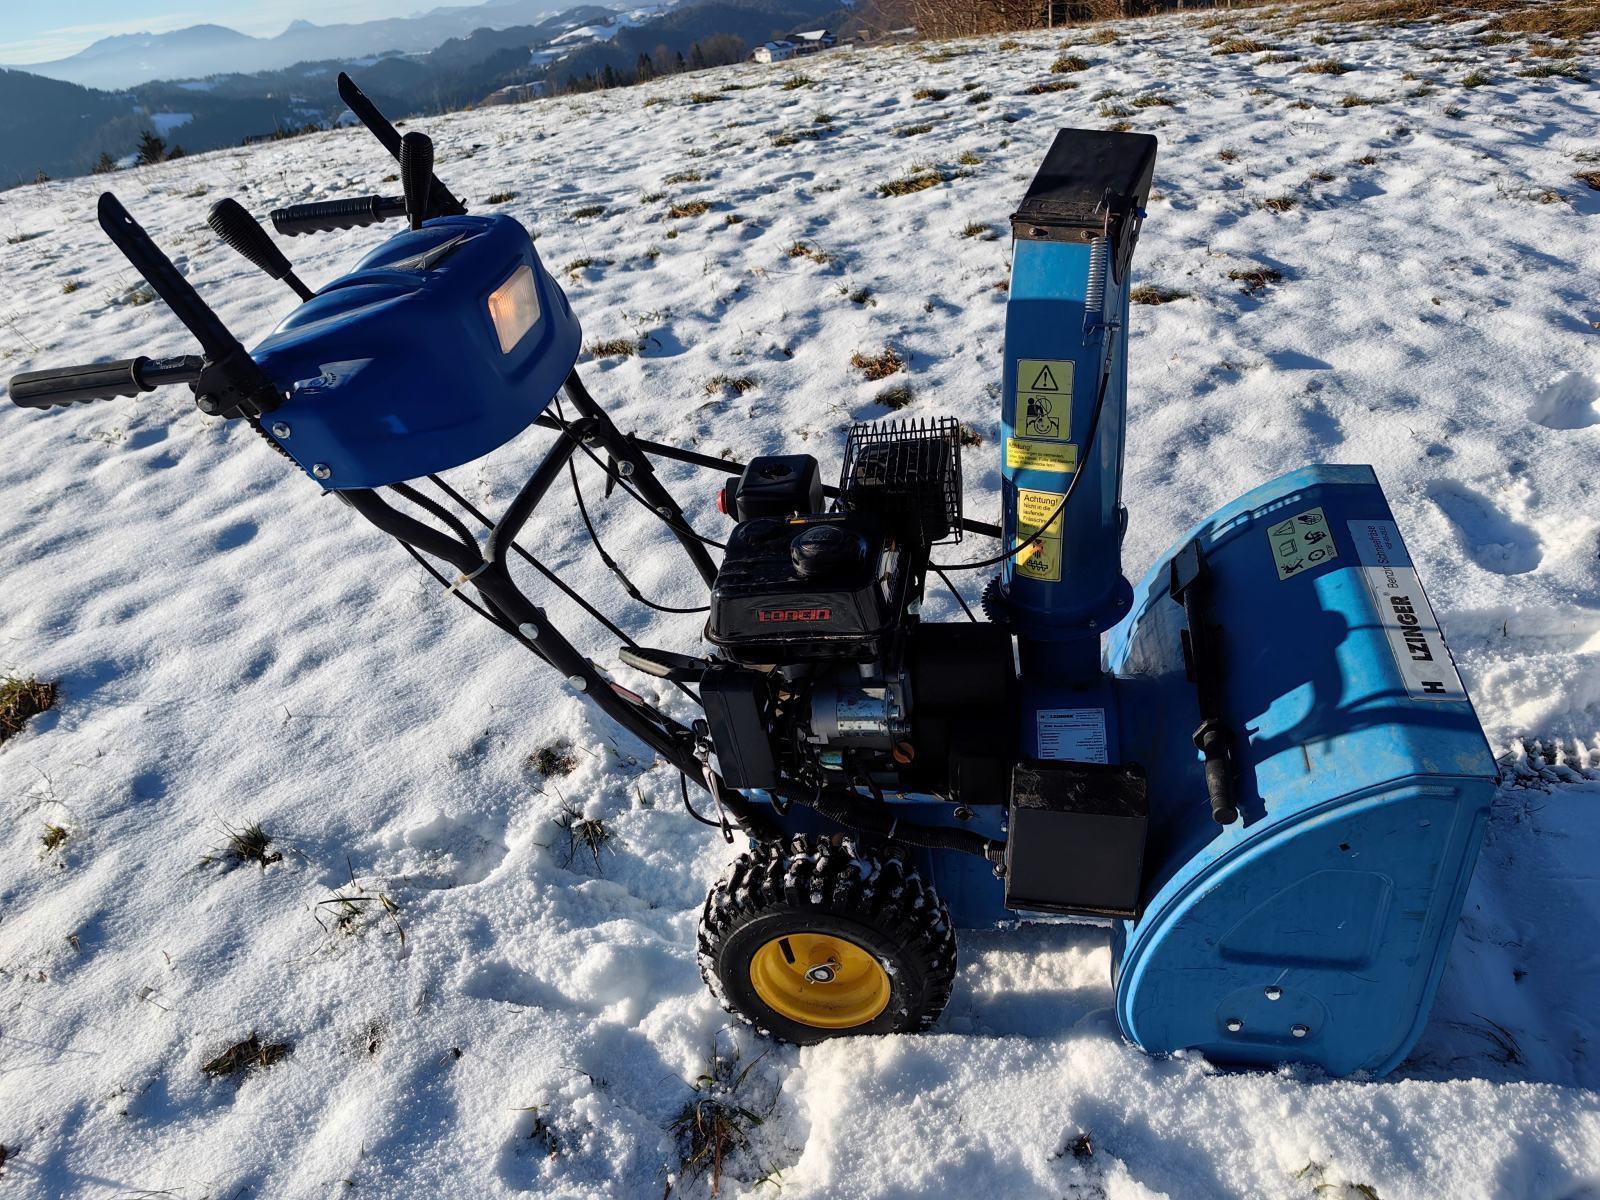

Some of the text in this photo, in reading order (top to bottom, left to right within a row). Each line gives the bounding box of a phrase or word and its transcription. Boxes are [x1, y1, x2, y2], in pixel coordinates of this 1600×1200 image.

[1024, 494, 1058, 506] Achtung!
[758, 608, 831, 622] LONCIN
[1367, 525, 1446, 694] HLZINGER Benzin Schneefräse
